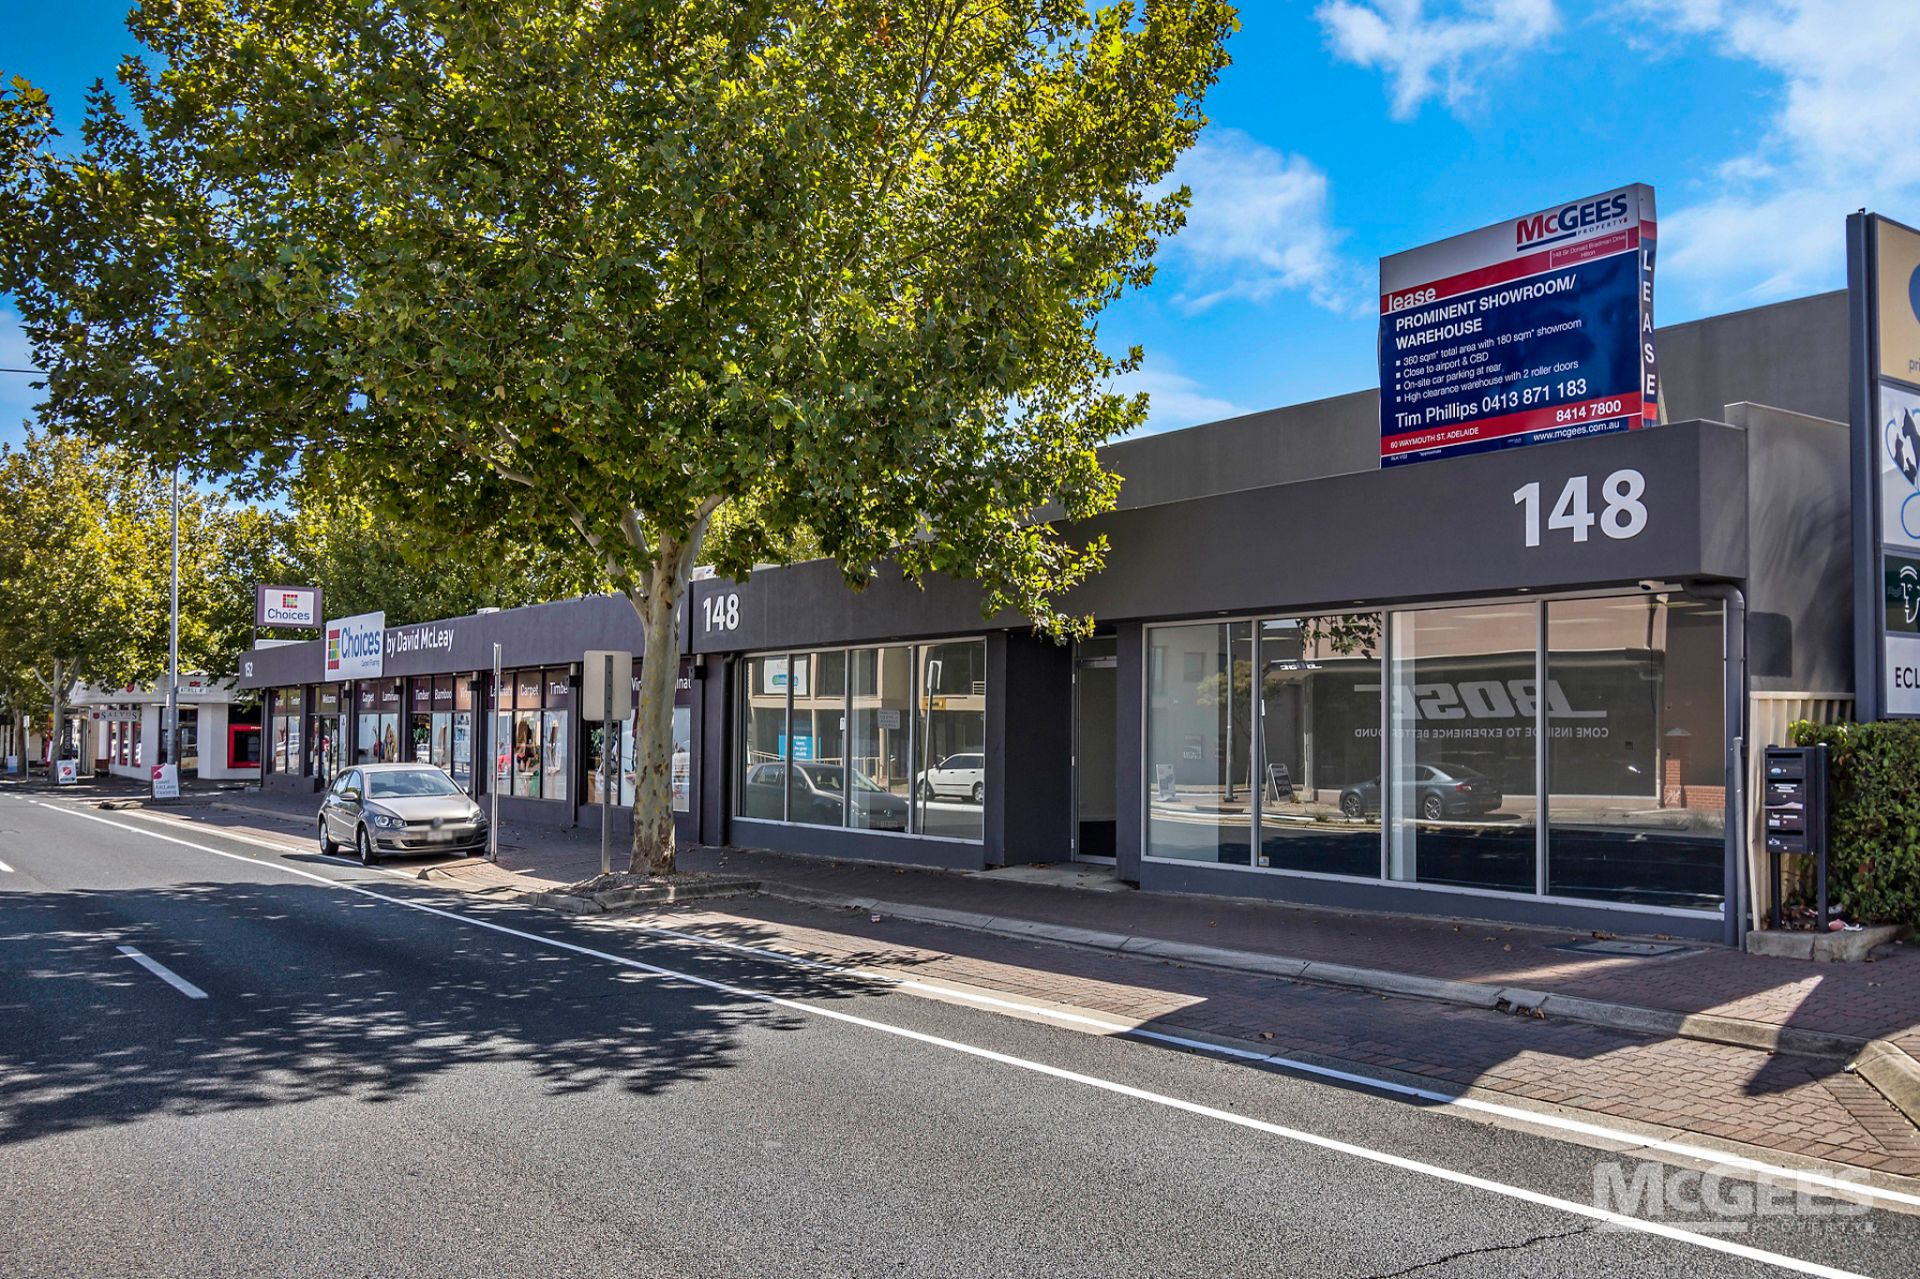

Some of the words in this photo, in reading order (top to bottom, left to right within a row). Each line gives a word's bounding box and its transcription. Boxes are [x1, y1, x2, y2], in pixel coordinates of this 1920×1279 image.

[1516, 194, 1628, 245] McGEES
[1578, 219, 1622, 236] PROPERTY
[1388, 287, 1436, 313] lease
[1396, 300, 1476, 332] PROMINENT
[1480, 274, 1576, 310] SHOWROOM/
[1396, 318, 1482, 350] WAREHOUSE
[1403, 355, 1418, 366] 360
[1441, 347, 1458, 358] total
[1459, 342, 1476, 354] area
[1478, 338, 1494, 349] with
[1497, 334, 1512, 345] 180
[1536, 319, 1582, 336] showroom
[1403, 367, 1424, 378] Close
[1426, 364, 1434, 374] to
[1436, 359, 1460, 371] airport
[1462, 356, 1468, 366] &
[1470, 352, 1489, 364] CBD
[1403, 378, 1430, 390] On-site
[1432, 375, 1444, 384] car
[1446, 370, 1475, 383] parking
[1476, 366, 1484, 376] at
[1486, 363, 1501, 372] rear
[1423, 385, 1459, 398] clearance
[1460, 376, 1502, 391] warehouse
[1504, 370, 1521, 382] with
[1523, 369, 1528, 378] 2
[1531, 365, 1551, 376] roller
[1553, 360, 1578, 372] doors
[1395, 412, 1421, 428] Tim
[1426, 402, 1478, 423] Phillips
[1482, 391, 1518, 412] 0413
[1523, 385, 1549, 405] 871
[1557, 378, 1587, 398] 183
[1556, 406, 1586, 422] 8414
[1590, 400, 1622, 416] 7800
[1400, 436, 1436, 447] WAYMOUTH
[1447, 427, 1479, 438] ADELAIDE
[1534, 421, 1620, 441] www.mcgees.com.au
[1513, 468, 1648, 548] 148
[267, 608, 310, 620] Choices
[703, 593, 739, 632] 148
[341, 624, 380, 659] Choices
[387, 633, 396, 658] by
[397, 628, 419, 652] David
[421, 625, 454, 652] McLeay
[416, 689, 430, 700] Timber
[435, 688, 452, 700] Bamboo
[520, 684, 539, 698] Carpet
[550, 682, 568, 695] Timbe
